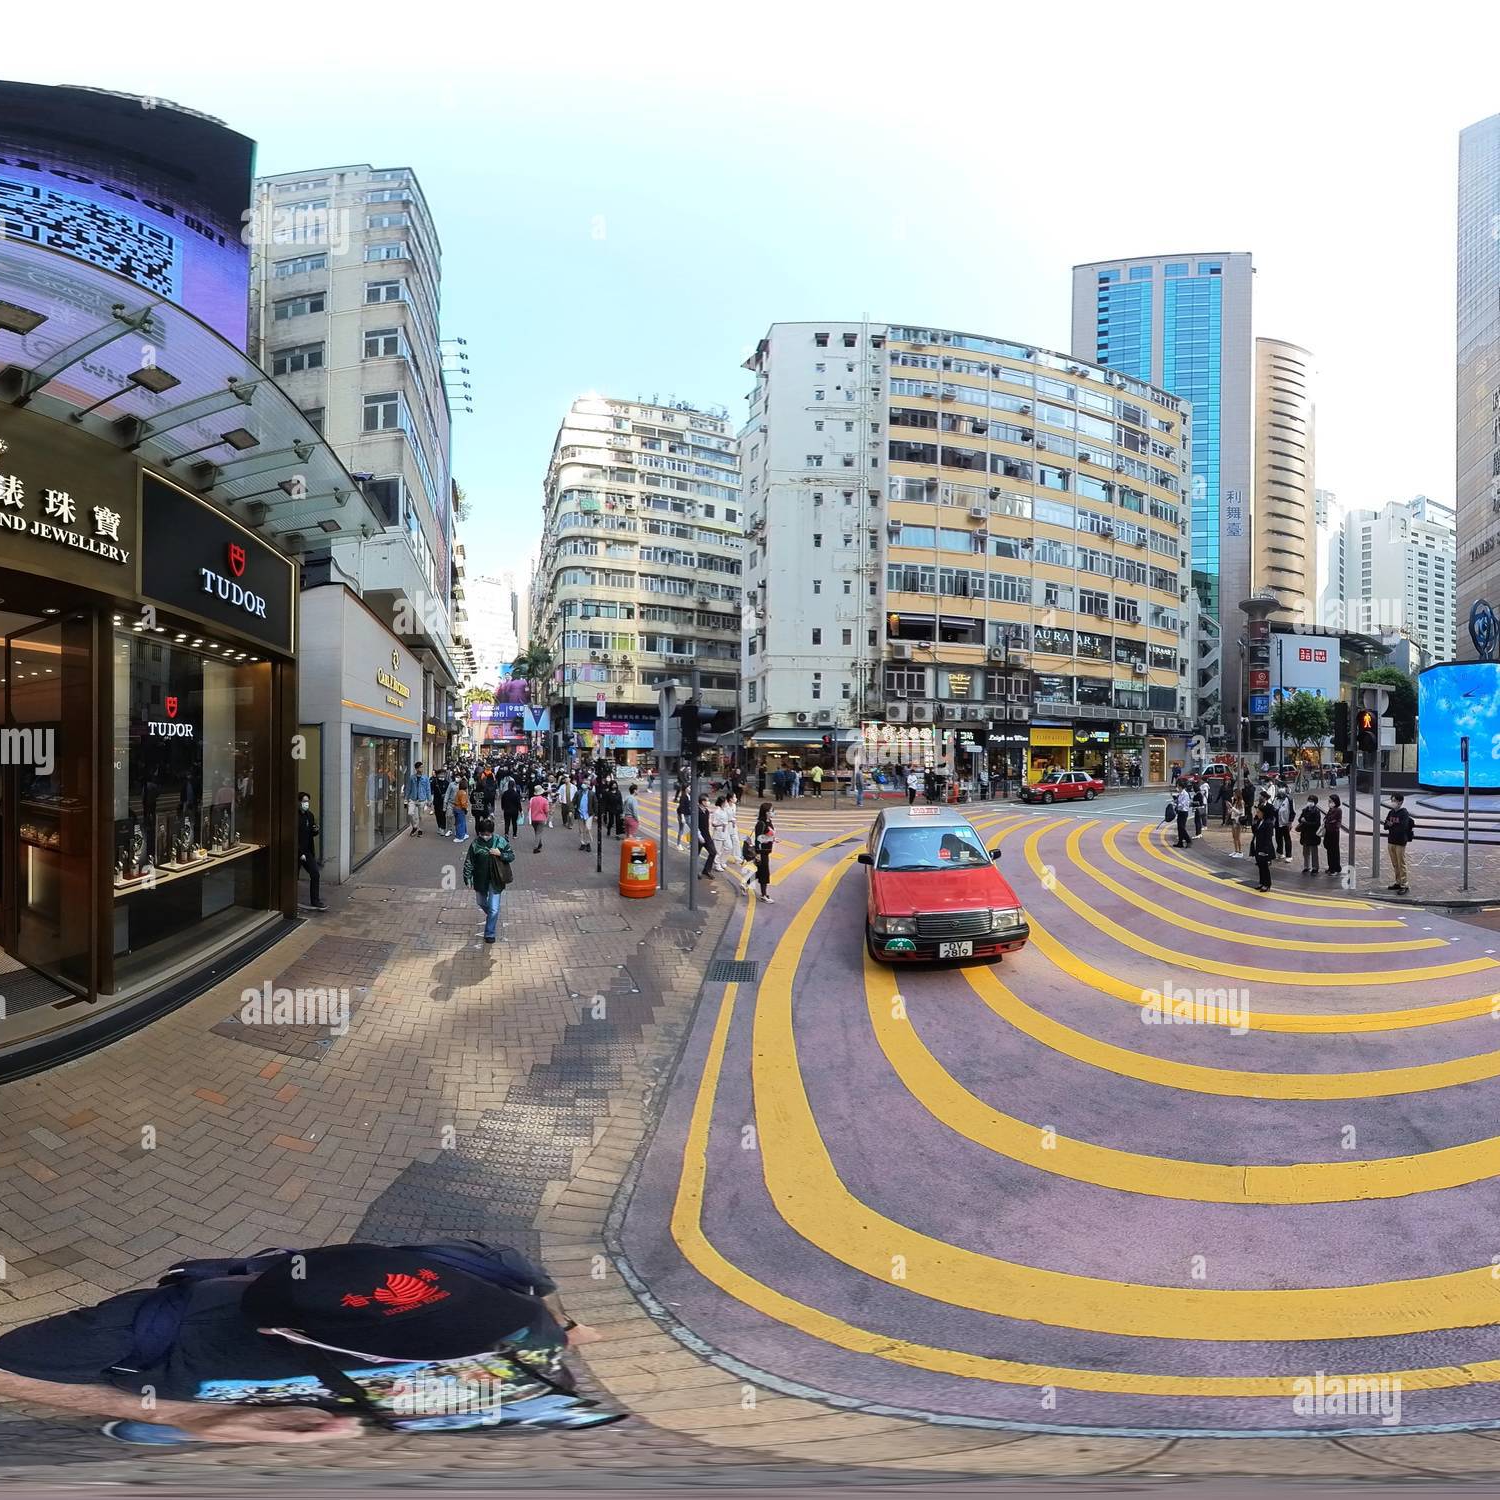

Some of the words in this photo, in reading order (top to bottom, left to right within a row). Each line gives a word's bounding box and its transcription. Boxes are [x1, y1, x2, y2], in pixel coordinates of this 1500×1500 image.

[1226, 490, 1242, 536] 利舞臺
[30, 520, 131, 564] JEWELLERY
[201, 567, 267, 619] TUDOR
[1035, 629, 1070, 642] AURA
[1077, 634, 1101, 647] ART
[148, 721, 194, 737] TUDOR
